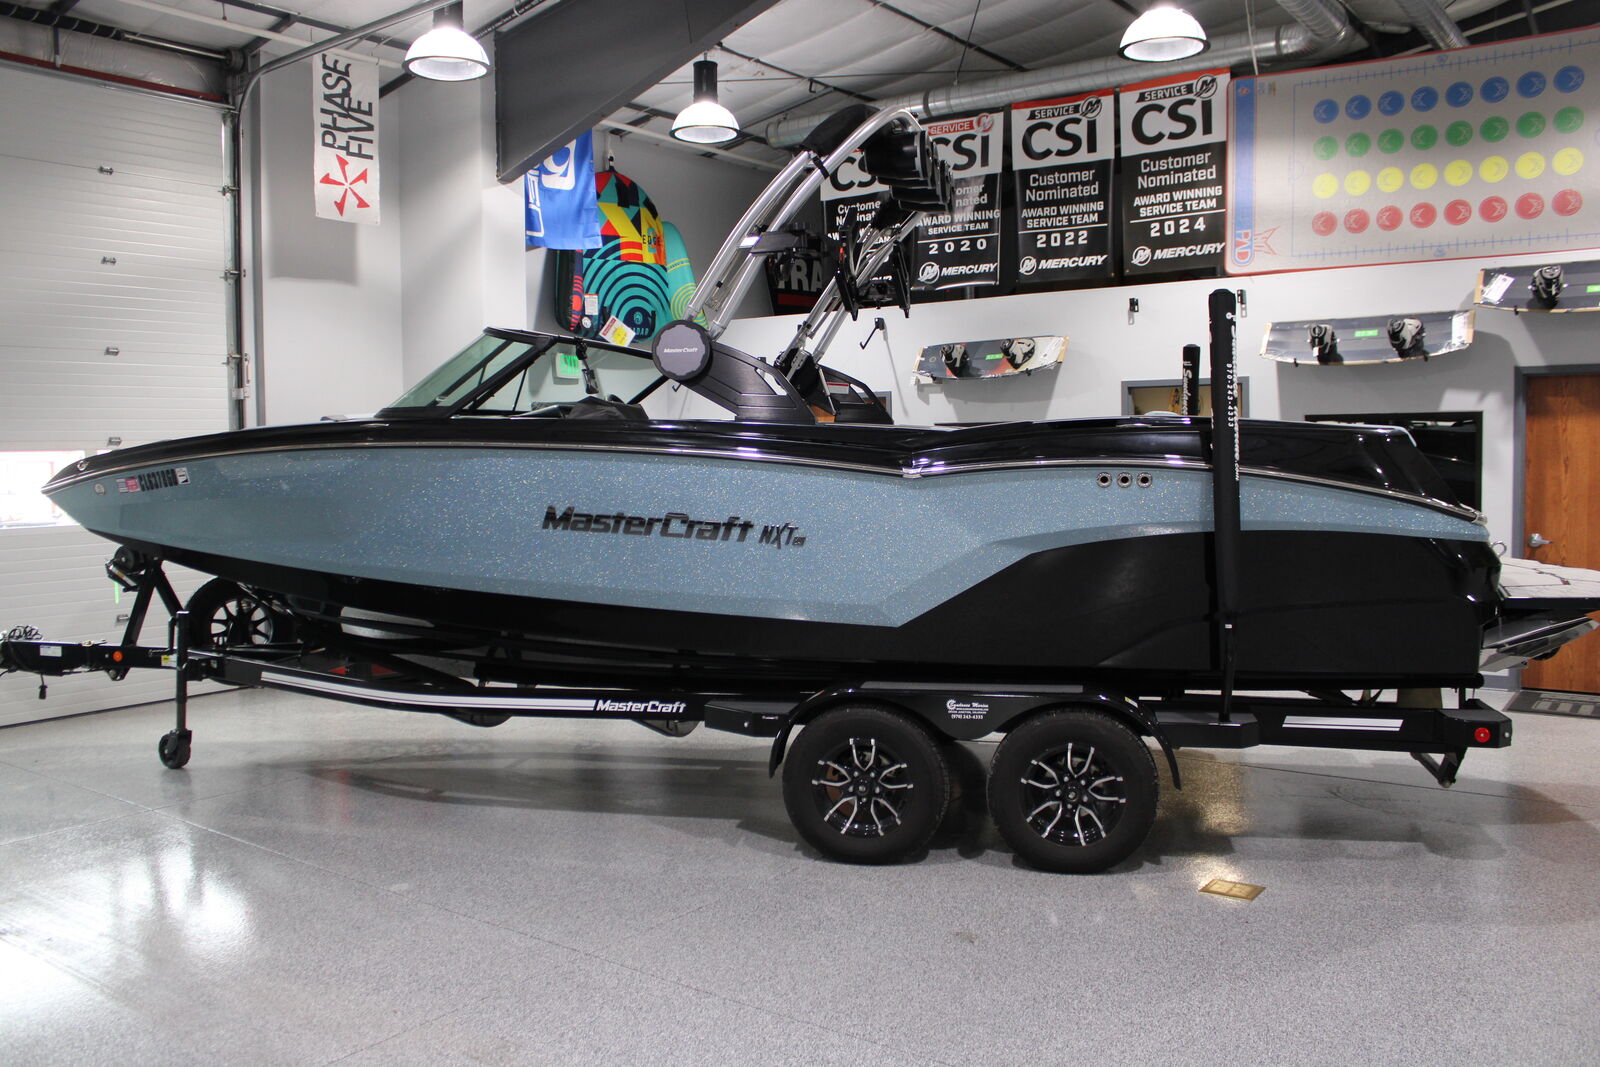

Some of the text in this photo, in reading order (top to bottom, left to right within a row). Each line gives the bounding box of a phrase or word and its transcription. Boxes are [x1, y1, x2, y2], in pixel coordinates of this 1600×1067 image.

[1144, 85, 1187, 101] SERVICE
[320, 53, 352, 152] PHASE
[1035, 105, 1074, 119] SERVICE
[346, 100, 374, 160] FIVE
[931, 121, 970, 134] SERVICE
[1131, 98, 1212, 145] CSI
[1022, 117, 1097, 160] CSI
[1141, 152, 1211, 172] Customer
[830, 155, 877, 192] CS
[1029, 170, 1095, 187] Customer
[1137, 165, 1216, 189] Nominated
[955, 184, 984, 195] omer
[1026, 181, 1099, 202] Nominated
[1133, 186, 1222, 206] AWARD WINNING
[955, 193, 988, 207] nated
[1140, 198, 1216, 217] SERVICE TEAM
[916, 209, 1000, 227] AWARD WINNING
[1021, 201, 1104, 218] AWARD WINNING
[928, 222, 988, 235] SERVICE TEAM
[1026, 213, 1098, 228] SERVICE TEAM
[1150, 217, 1205, 237] 2024
[929, 238, 987, 254] 2020
[1036, 230, 1088, 248] 2022
[1153, 242, 1225, 260] MERCURY
[941, 263, 998, 277] MERCURY
[1038, 255, 1108, 269] MERCURY
[542, 505, 799, 549] MasterCraft NXT
[596, 699, 686, 713] MasterCraft
